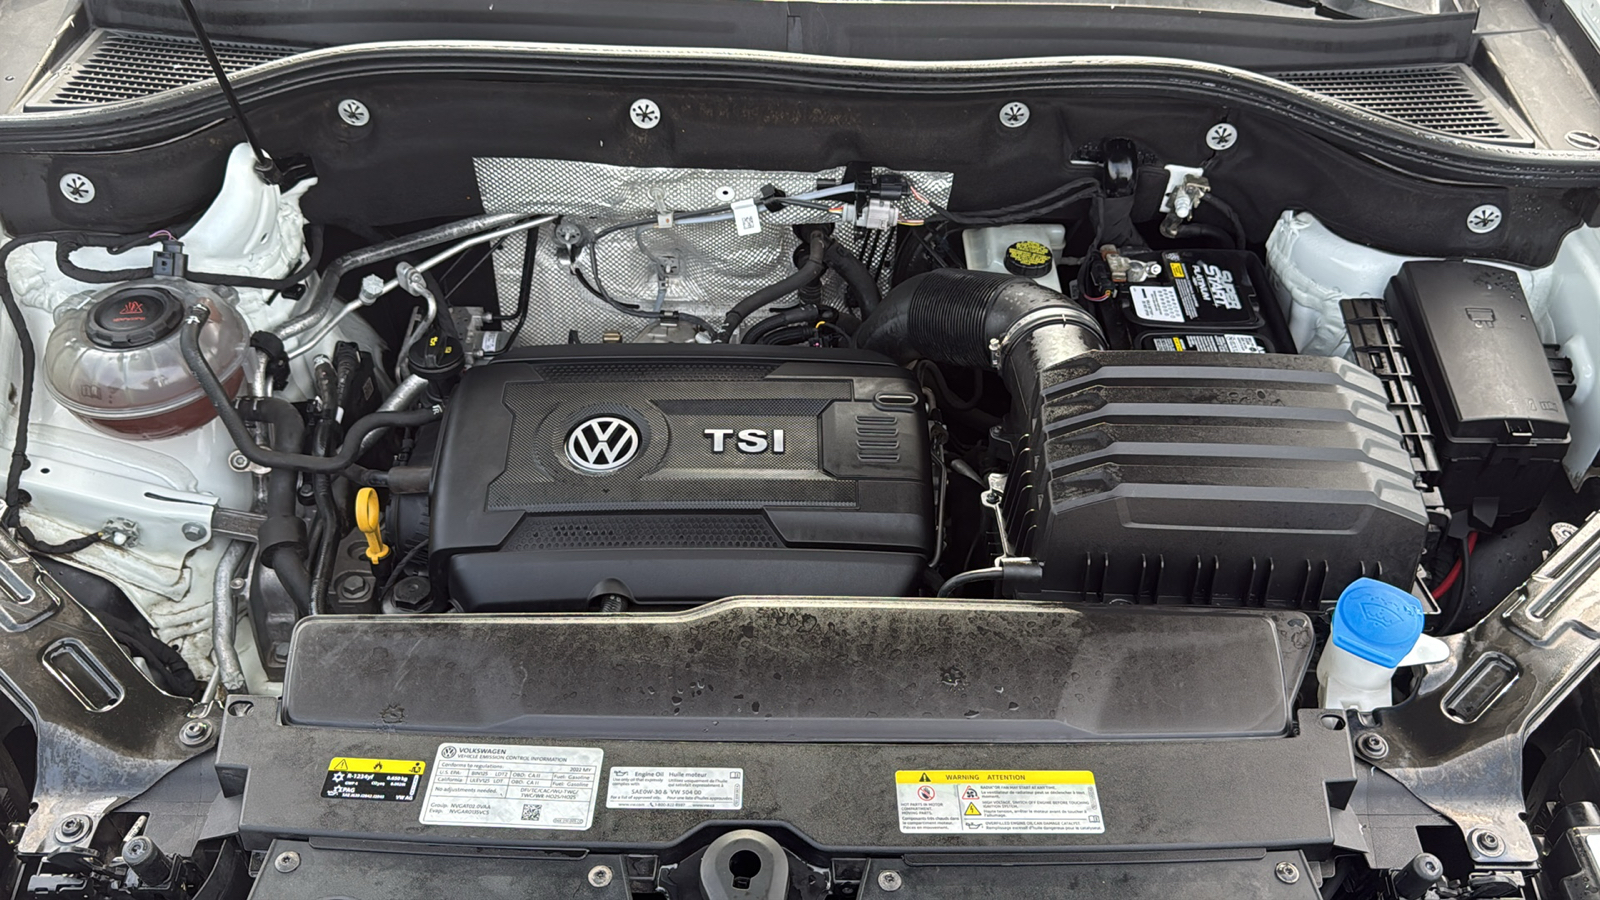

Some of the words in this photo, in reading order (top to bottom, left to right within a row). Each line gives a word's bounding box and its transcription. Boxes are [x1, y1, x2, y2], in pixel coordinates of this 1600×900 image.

[1192, 264, 1212, 301] PLATINUM
[1203, 264, 1227, 308] START
[1222, 270, 1242, 310] SUPER
[704, 429, 784, 454] TSI
[459, 747, 507, 755] VOLKSWAGEN
